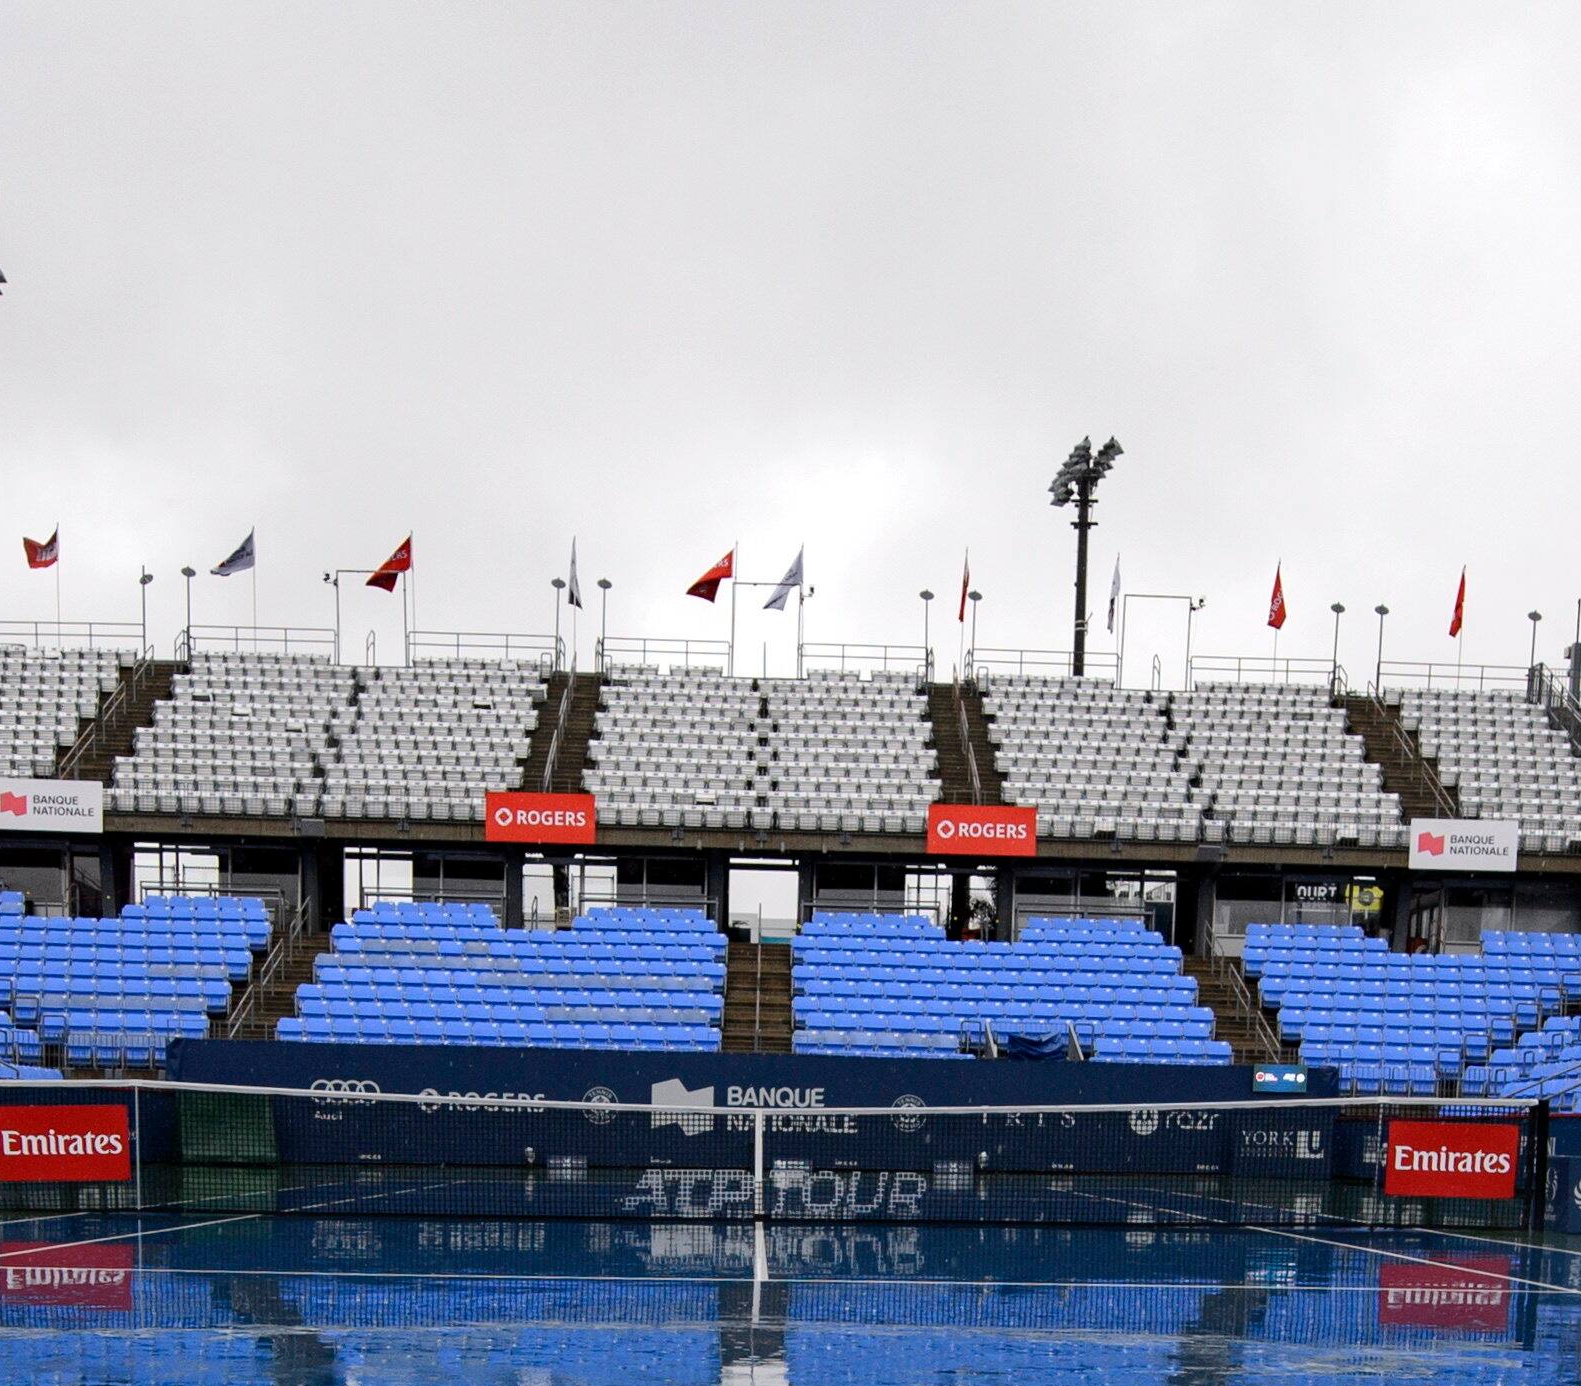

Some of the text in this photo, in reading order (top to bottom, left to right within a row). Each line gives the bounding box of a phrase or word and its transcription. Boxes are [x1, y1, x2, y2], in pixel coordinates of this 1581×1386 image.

[33, 794, 78, 806] BANQUE
[33, 806, 95, 817] NATIONALE
[516, 809, 586, 827] ROGERS
[958, 821, 1028, 839] ROGERS
[1449, 834, 1495, 845] BANQUE
[1449, 846, 1509, 856] NATIONALE
[727, 1086, 825, 1107] BANQUE
[1, 1129, 123, 1155] Emirates
[1394, 1145, 1510, 1174] Emirates
[621, 1169, 927, 1213] ATP TOUR
